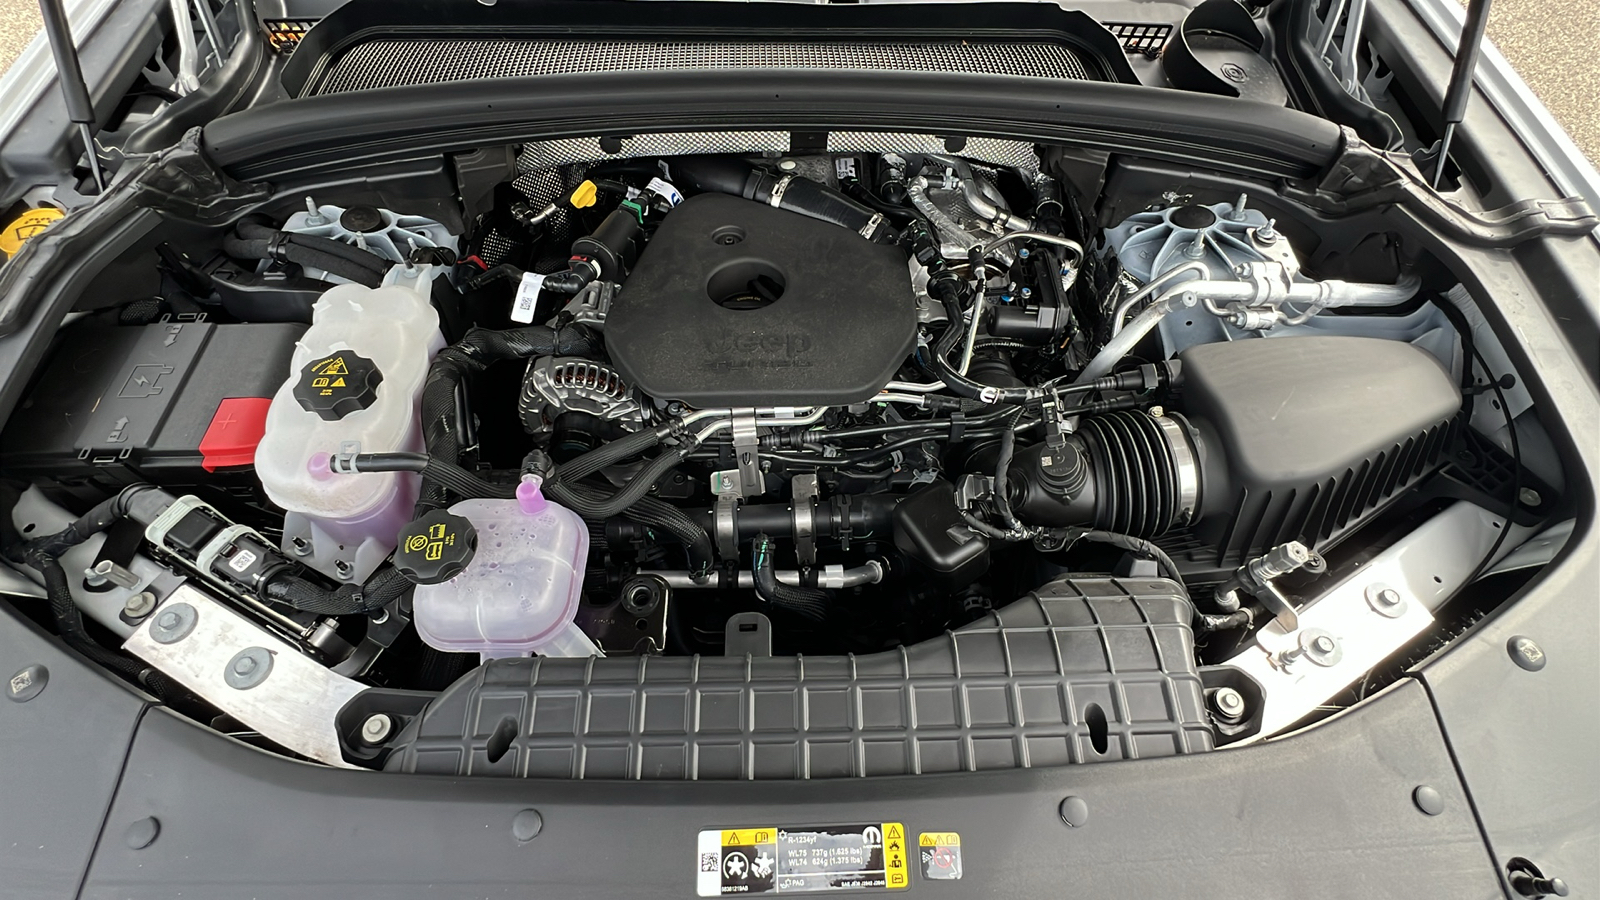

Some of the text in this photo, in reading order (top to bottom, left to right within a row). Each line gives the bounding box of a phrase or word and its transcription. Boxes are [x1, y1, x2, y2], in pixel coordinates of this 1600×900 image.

[788, 835, 817, 845] R-1234yf
[788, 849, 808, 858] WL75
[811, 848, 828, 858] 737g
[788, 858, 808, 867] WL74
[812, 858, 829, 867] 624g
[829, 856, 849, 866] (1.375
